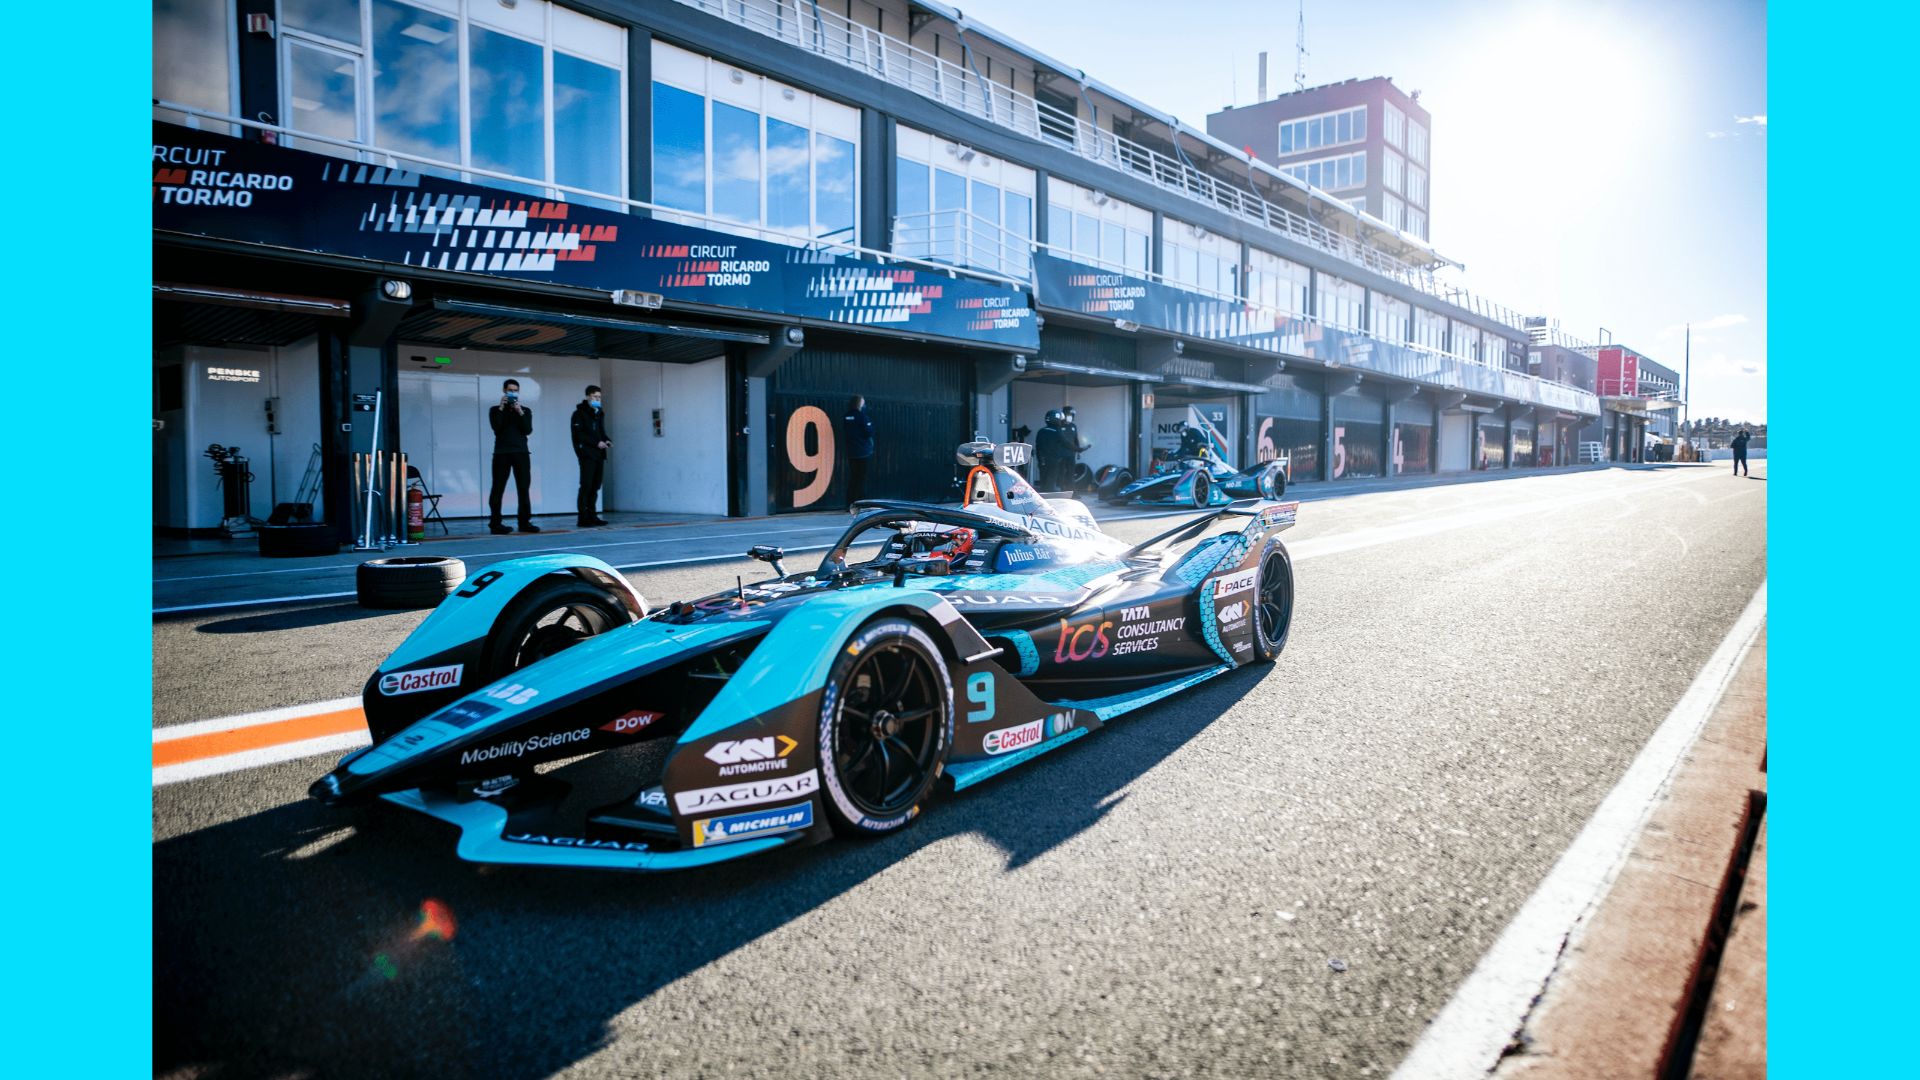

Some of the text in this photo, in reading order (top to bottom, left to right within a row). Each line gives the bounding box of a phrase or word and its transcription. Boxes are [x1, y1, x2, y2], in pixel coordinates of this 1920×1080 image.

[190, 169, 293, 190] RICARDO
[160, 186, 253, 207] TORMO
[690, 245, 737, 258] CIRCUIT
[720, 260, 770, 272] RICARDO
[707, 273, 751, 286] TORMO
[1096, 274, 1124, 287] CIRCUIT
[1114, 286, 1146, 298] RICARDO
[982, 297, 1010, 308] CIRCUIT
[1109, 299, 1135, 311] TORMO
[1001, 307, 1030, 318] RICARDO
[994, 318, 1020, 329] TORMO
[786, 405, 836, 508] 9
[1003, 446, 1025, 464] EVA
[1333, 427, 1345, 479] 5
[1392, 427, 1405, 474] 4
[1004, 548, 1035, 565] Julius
[1035, 547, 1051, 560] Bär
[455, 571, 505, 598] 9
[1120, 605, 1150, 621] TATA
[1117, 617, 1186, 639] CONSULTANCY
[1054, 618, 1114, 663] tcs
[1112, 637, 1159, 655] SERVICES
[400, 668, 457, 691] Castrol
[966, 671, 996, 723] 9
[1001, 723, 1040, 749] Castrol
[460, 727, 591, 765] MobilityScience
[718, 758, 788, 777] AUTOMOTIVE
[687, 776, 812, 808] JAGUAR
[729, 811, 804, 834] MICHELIN
[506, 833, 649, 850] JAGUAR
